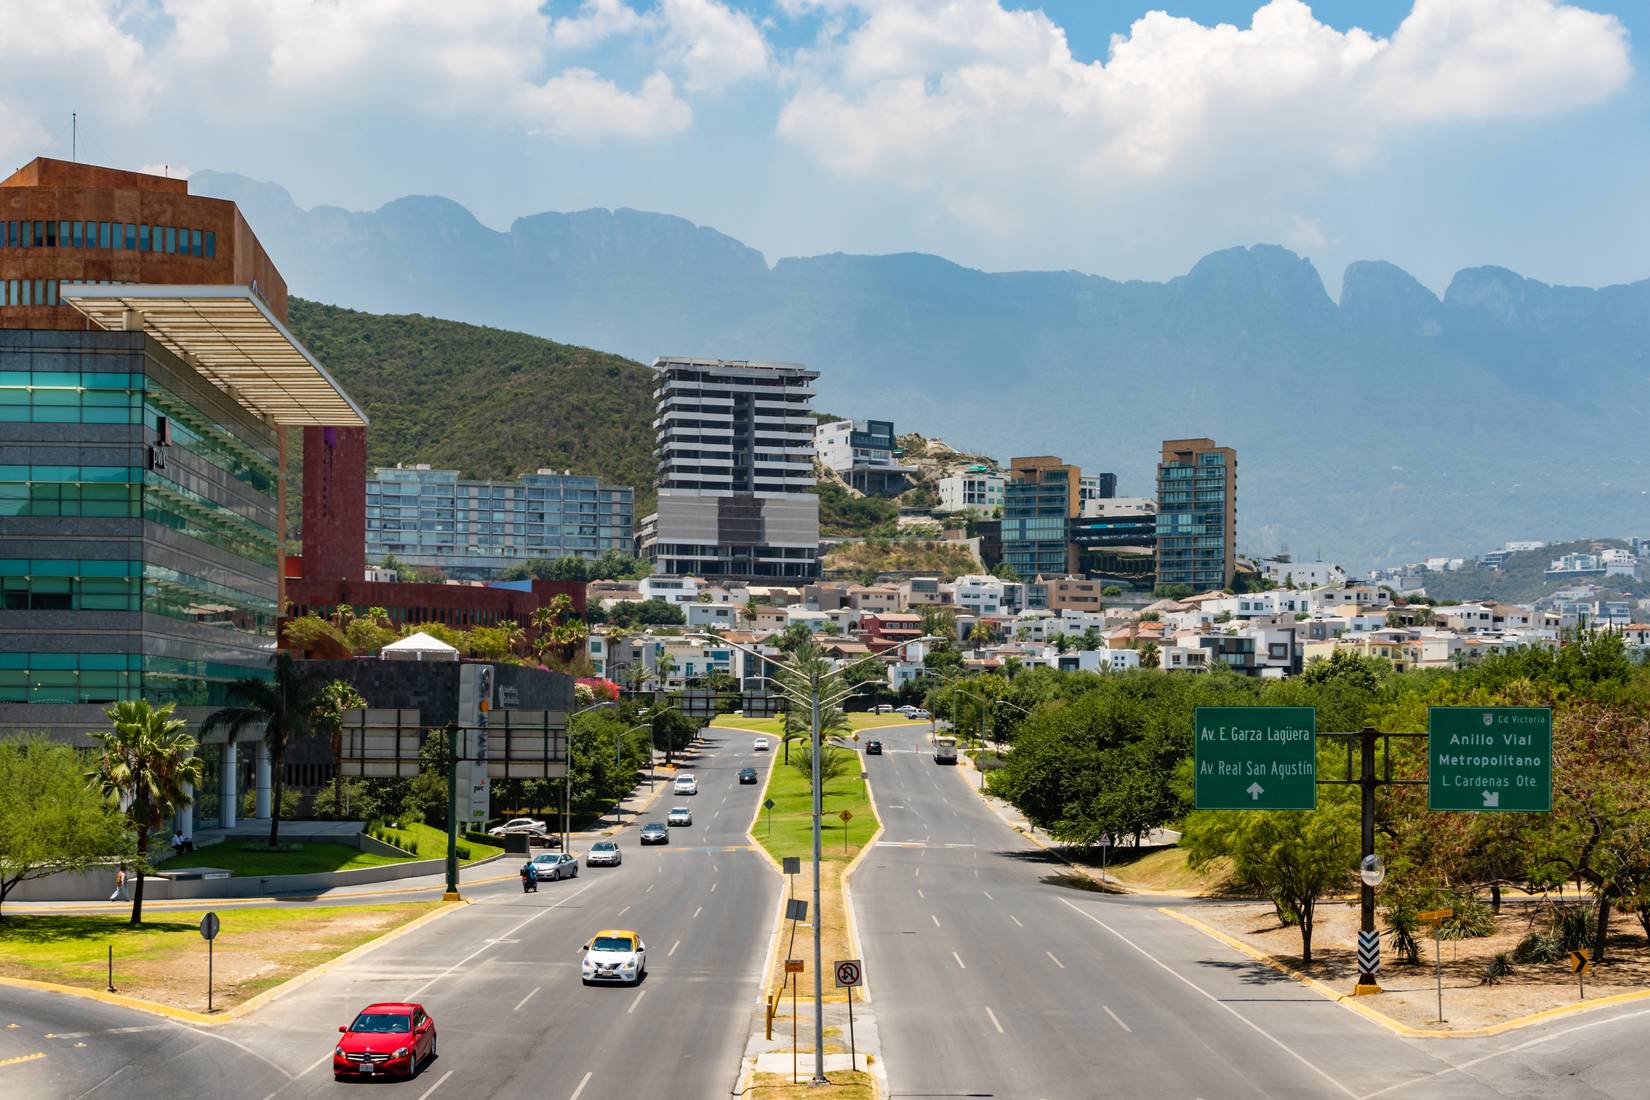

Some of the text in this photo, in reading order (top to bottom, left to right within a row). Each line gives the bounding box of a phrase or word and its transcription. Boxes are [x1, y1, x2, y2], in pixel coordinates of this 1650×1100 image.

[1512, 715, 1545, 724] Victoria
[1201, 726, 1310, 745] Av. E. Garza Lagüera
[1449, 733, 1532, 745] Anillo Vial
[1439, 753, 1541, 768] Metropolitano
[1218, 760, 1242, 775] Real
[1246, 760, 1266, 776] San
[1271, 760, 1313, 780] Agustín
[1455, 774, 1510, 787] Cardenas
